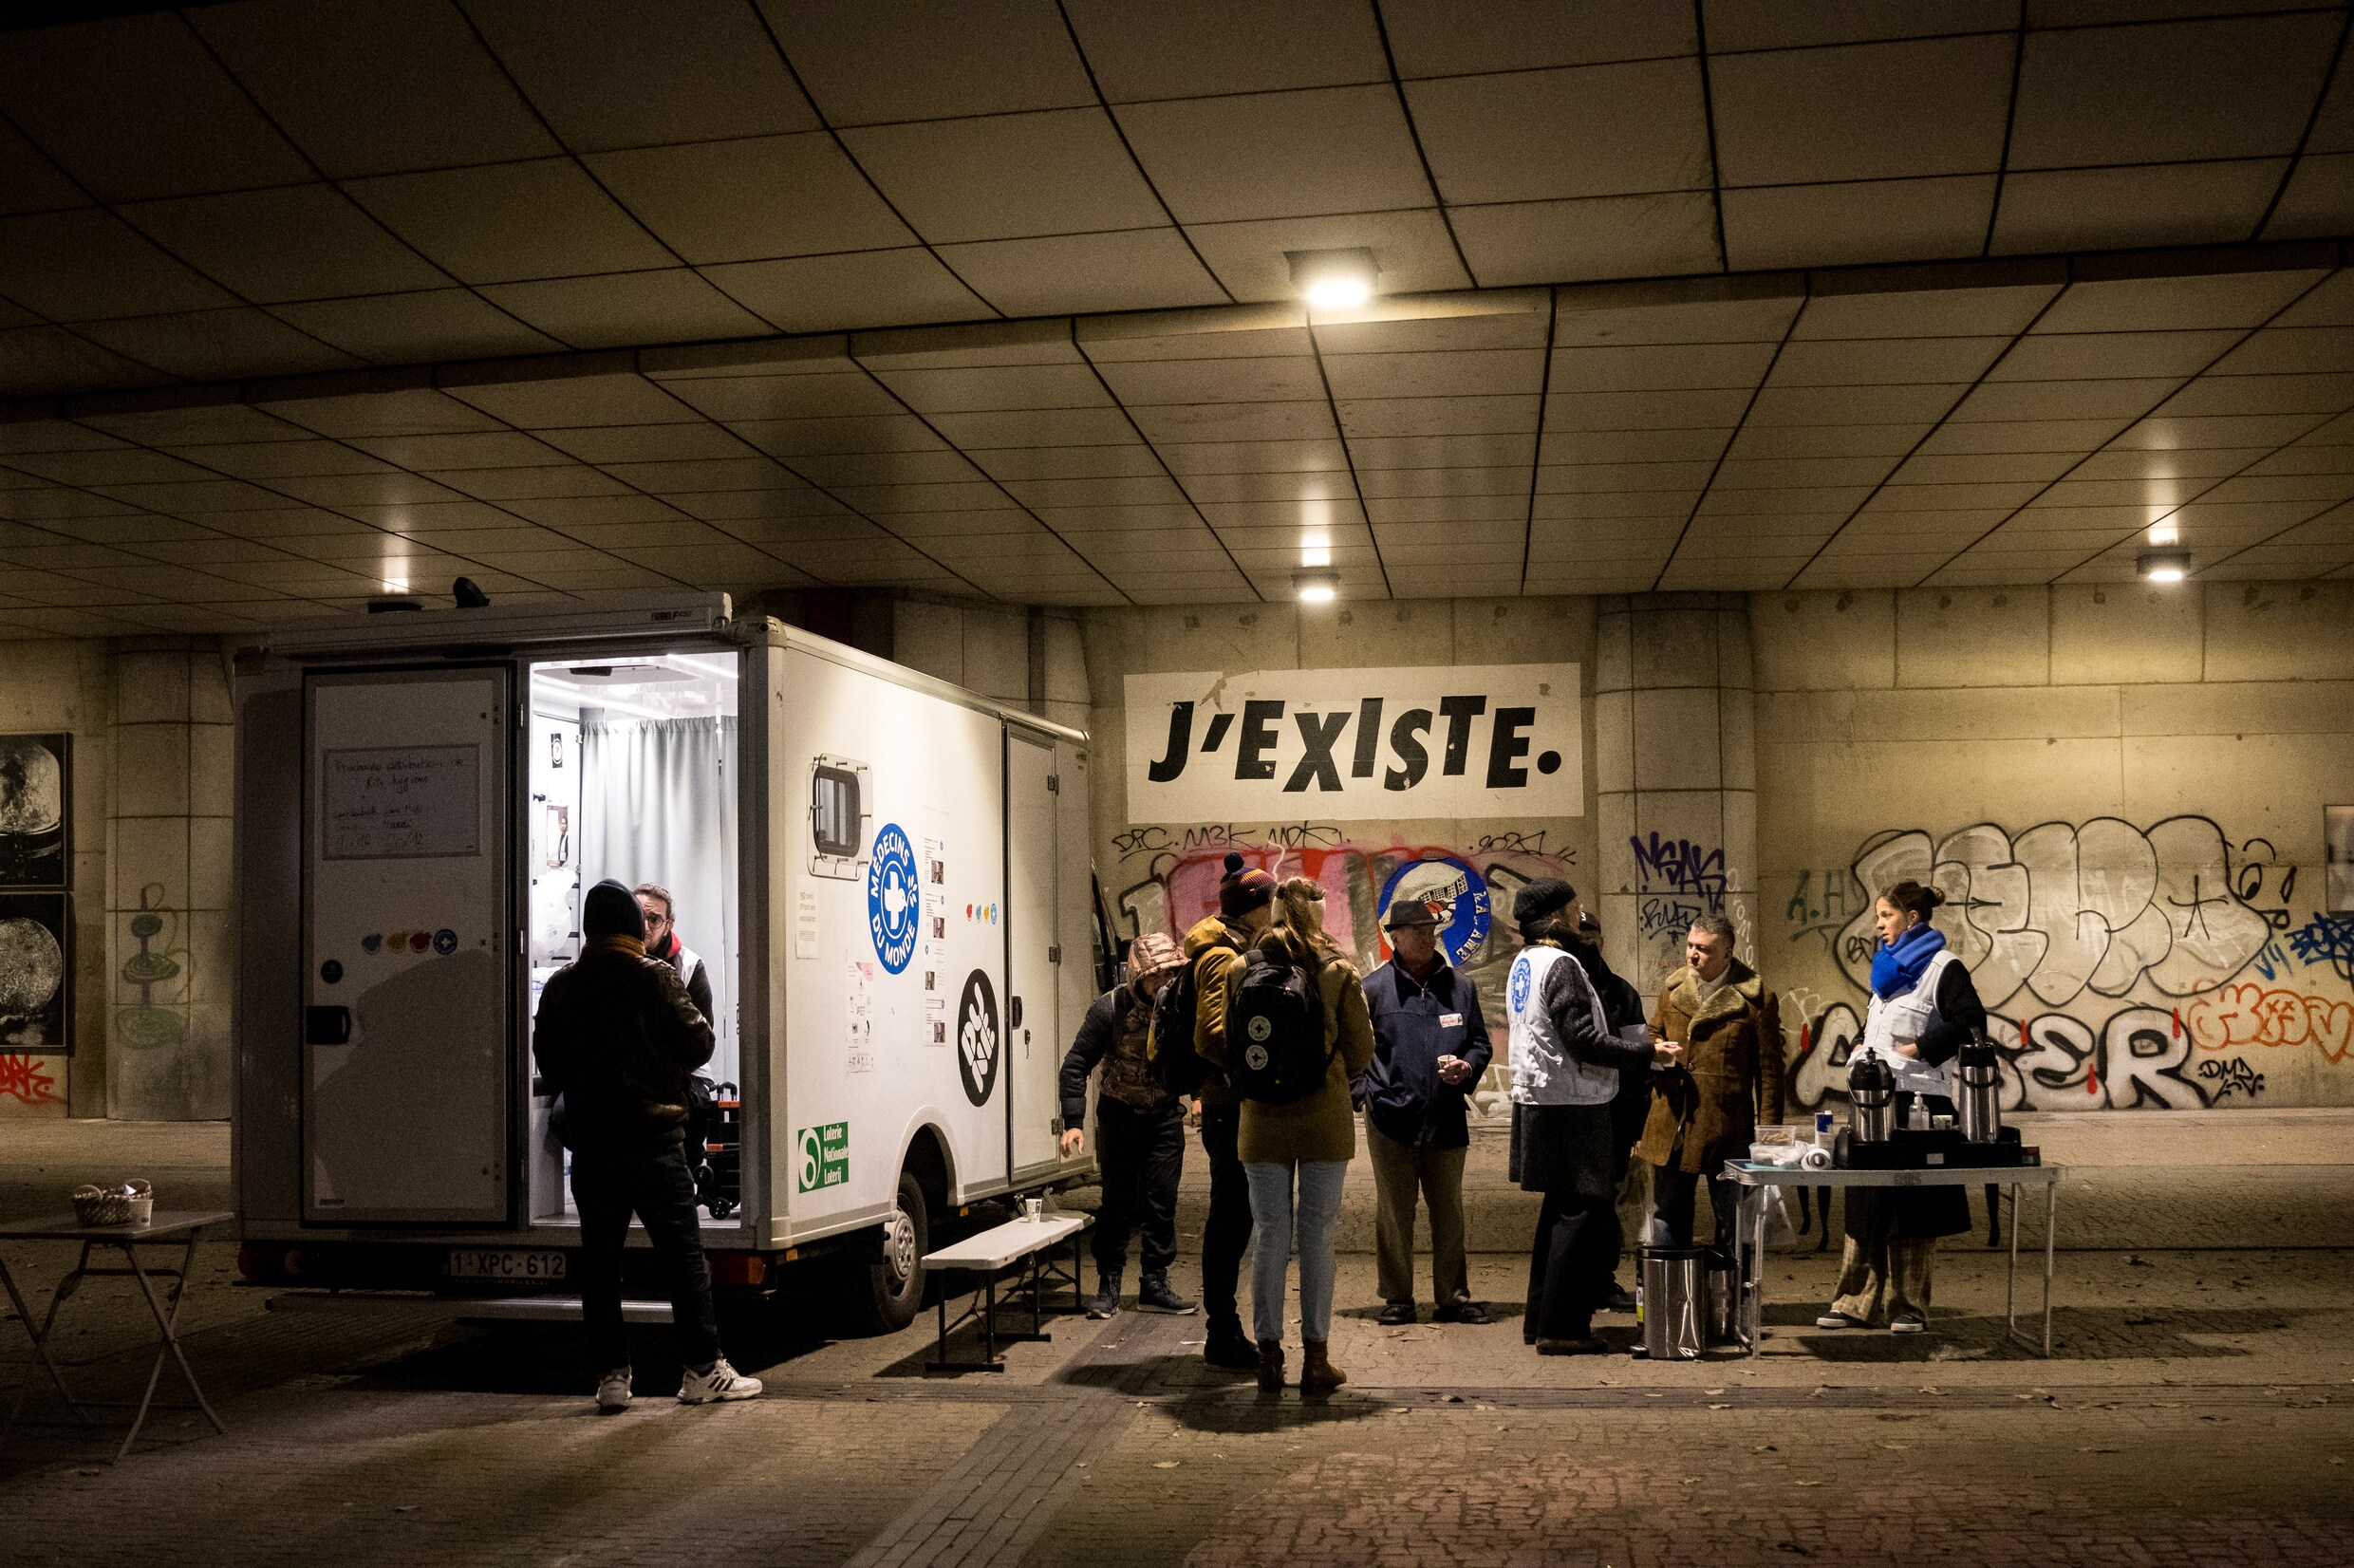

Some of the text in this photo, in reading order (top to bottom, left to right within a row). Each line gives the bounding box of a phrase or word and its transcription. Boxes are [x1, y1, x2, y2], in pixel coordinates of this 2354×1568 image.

[1148, 695, 1562, 792] J'EXISTE.
[872, 913, 916, 967] DU MONDE
[824, 1124, 843, 1142] Loterie
[824, 1145, 850, 1164] Nationale
[824, 1167, 842, 1185] Loterij
